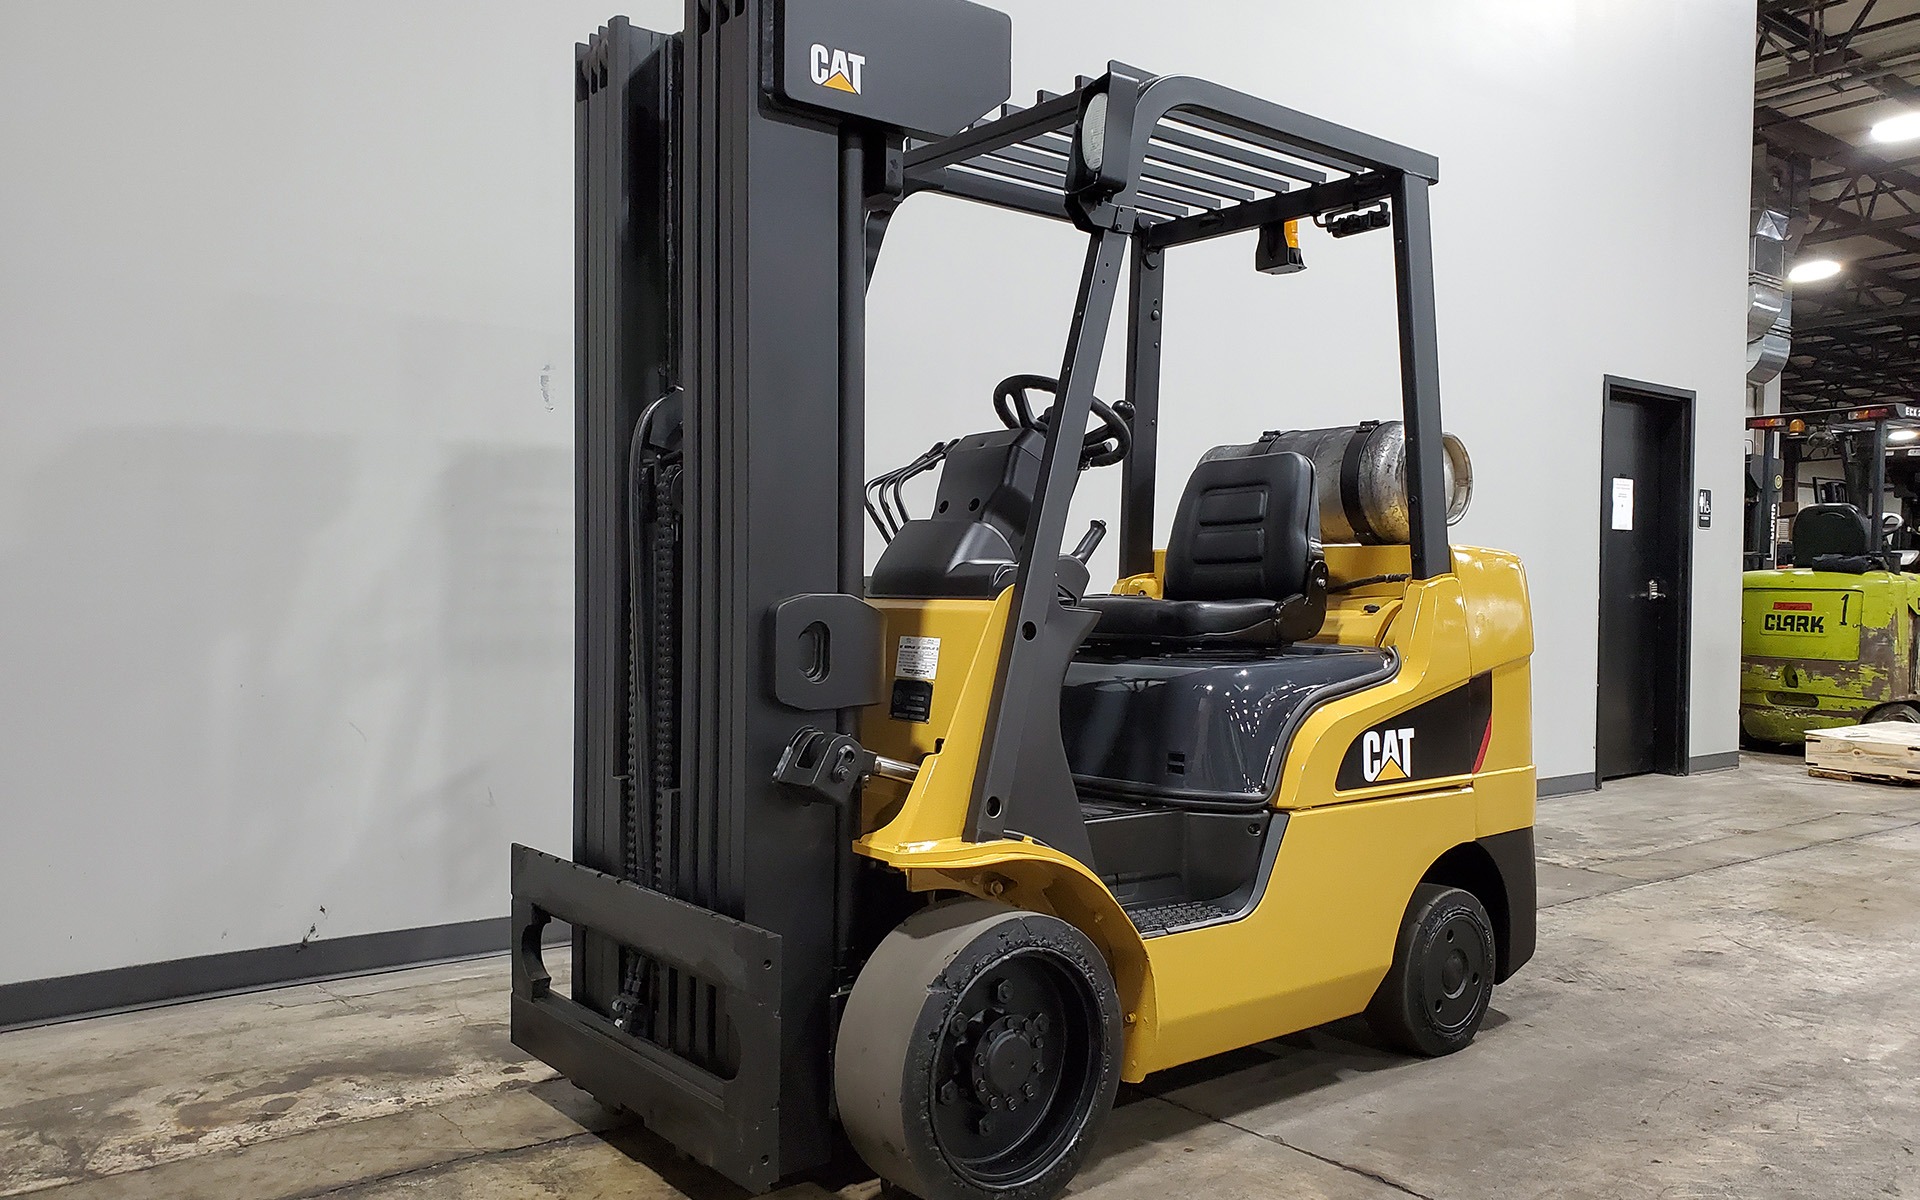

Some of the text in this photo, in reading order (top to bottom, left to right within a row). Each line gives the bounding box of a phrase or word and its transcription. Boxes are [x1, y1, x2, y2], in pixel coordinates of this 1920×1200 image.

[810, 43, 866, 95] CAT
[1764, 613, 1825, 634] CLARK
[1840, 593, 1850, 626] 1
[1362, 727, 1415, 782] CAT
